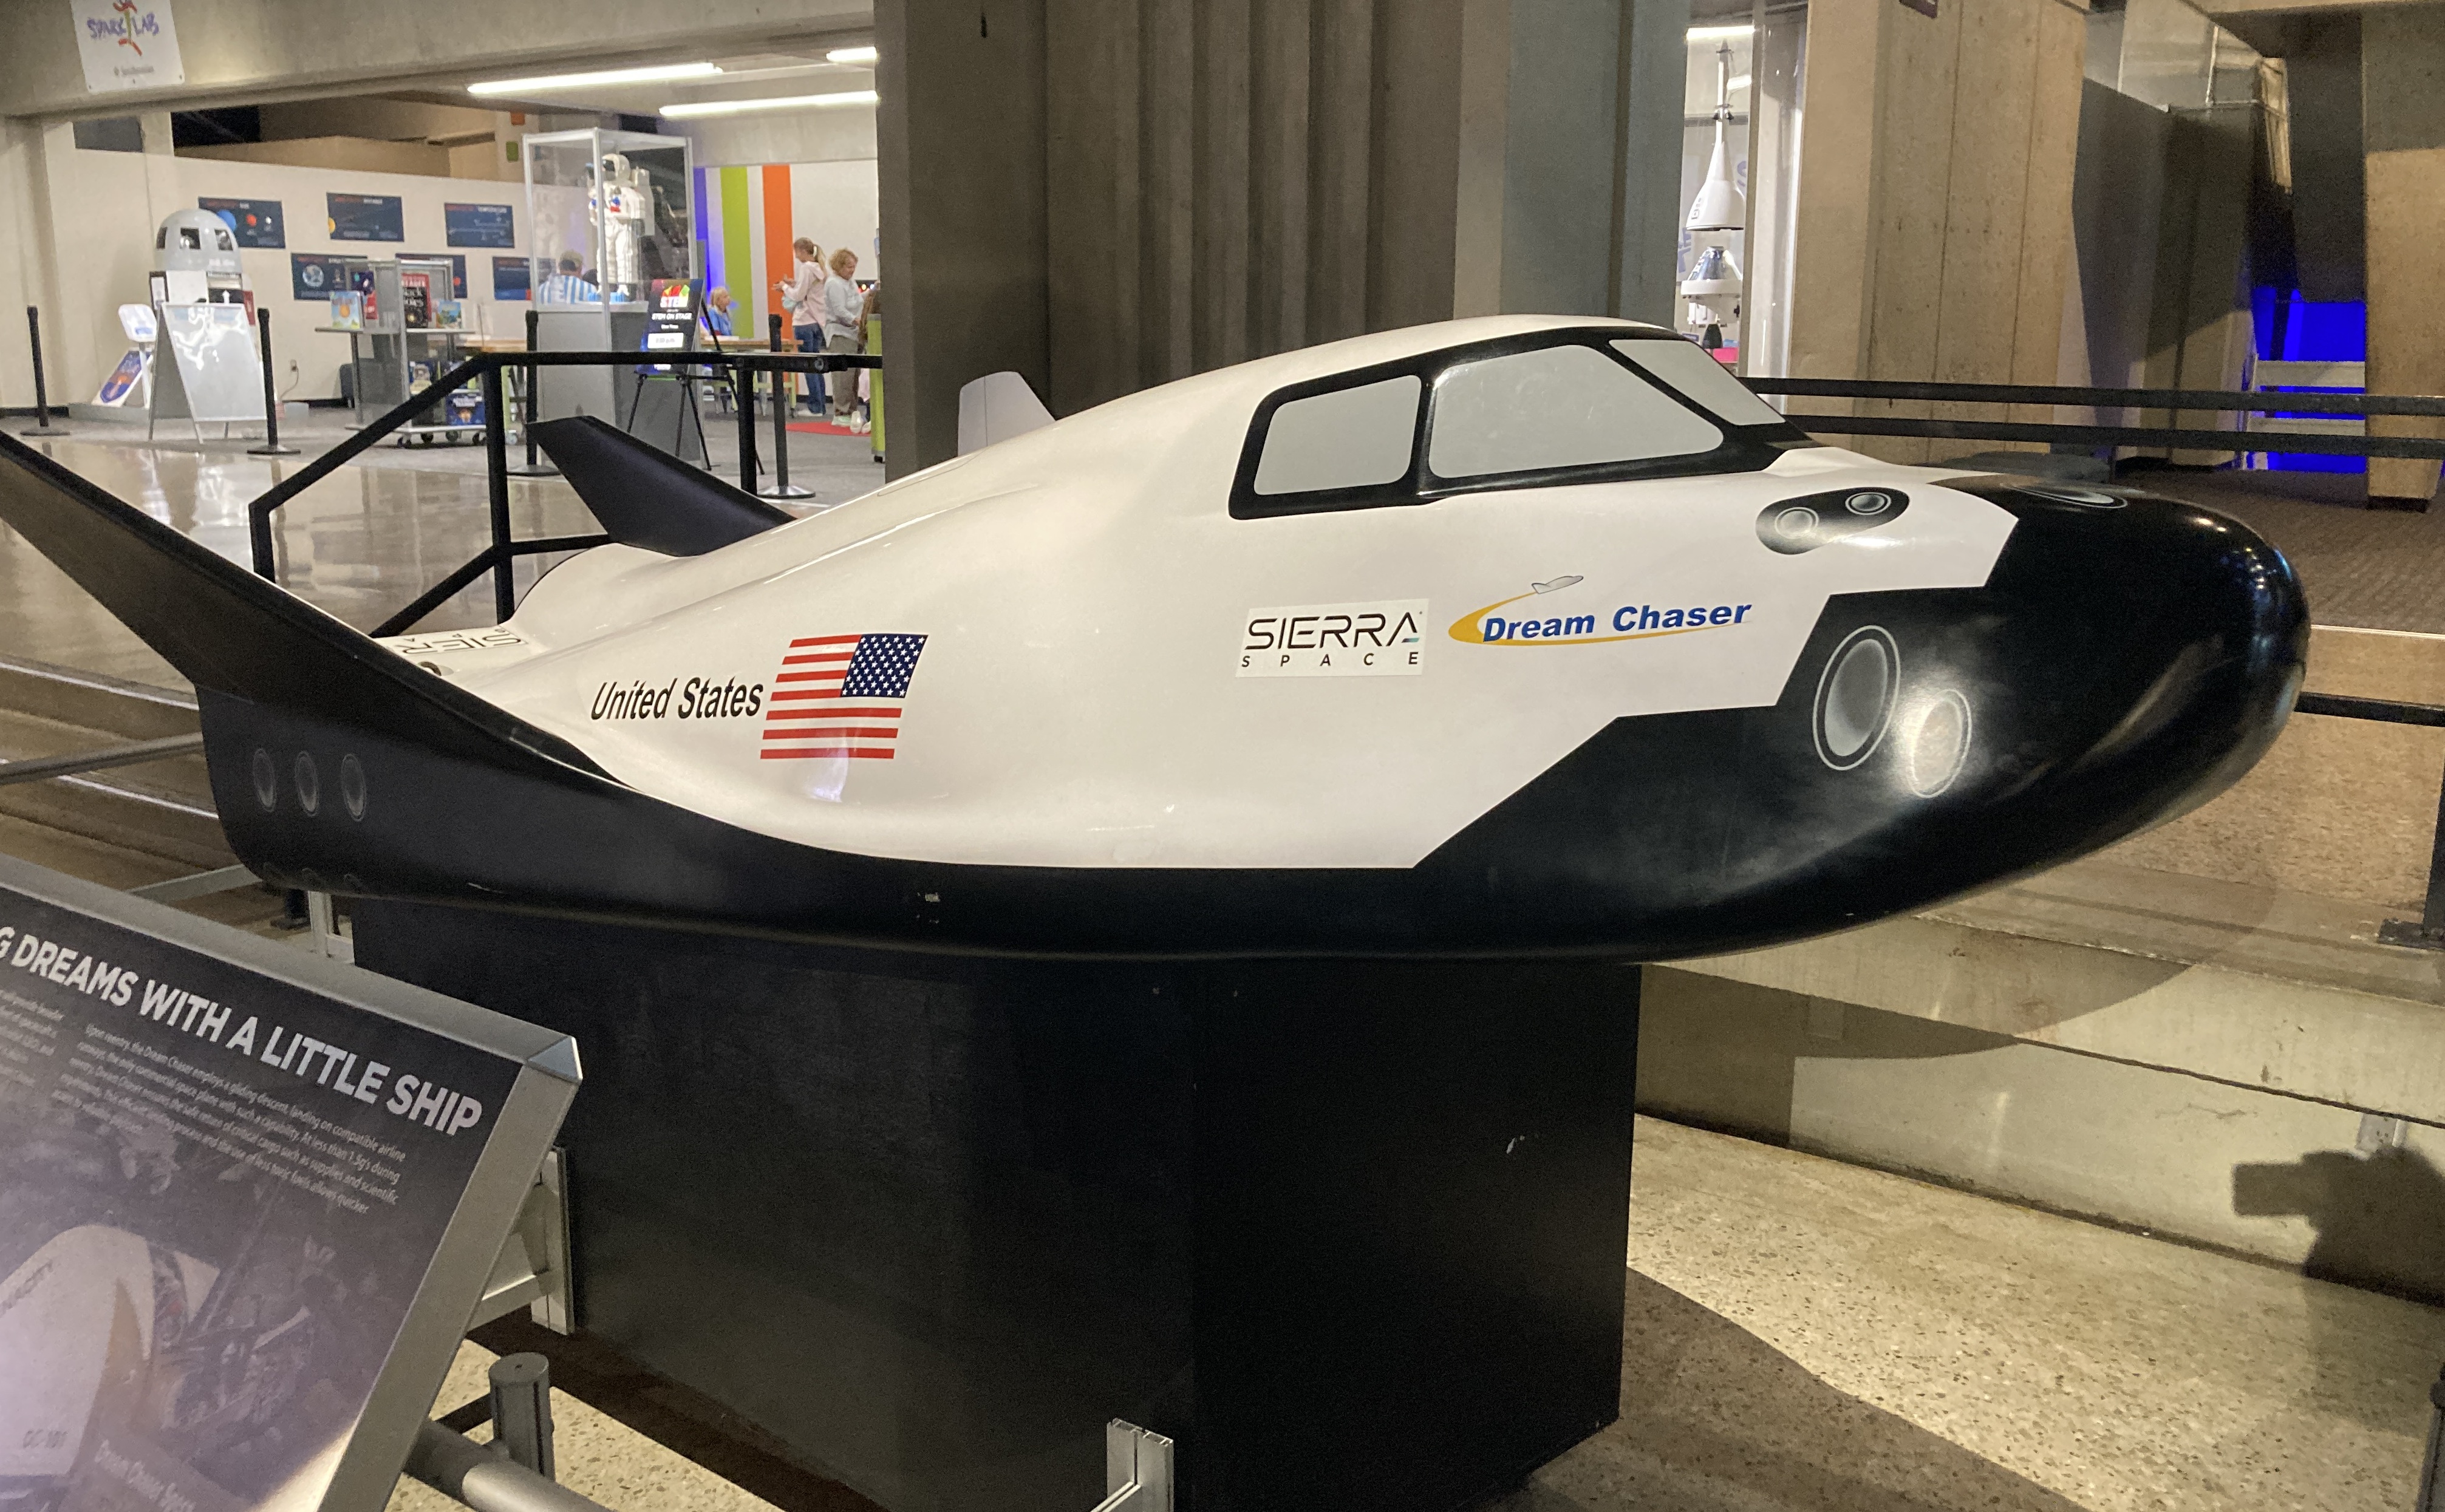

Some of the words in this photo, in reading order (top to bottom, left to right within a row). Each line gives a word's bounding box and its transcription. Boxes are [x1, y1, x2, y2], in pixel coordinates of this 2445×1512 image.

[1244, 611, 1420, 650] SIERRA
[1482, 614, 1595, 642] Dream
[1612, 604, 1753, 632] Chaser
[1241, 652, 1419, 667] SPACE
[590, 676, 678, 720] United
[677, 675, 764, 720] States
[11, 933, 139, 1007] DREAMS
[138, 979, 233, 1043] WITH
[225, 1016, 259, 1057] A
[259, 1025, 390, 1106] LITTLE
[386, 1073, 483, 1137] SHIP
[312, 1136, 327, 1151] less
[327, 1144, 347, 1159] than
[371, 1162, 400, 1185] during
[321, 1121, 332, 1131] on
[333, 1126, 378, 1150] compatible
[378, 1145, 405, 1162] airline
[343, 1175, 363, 1188] and
